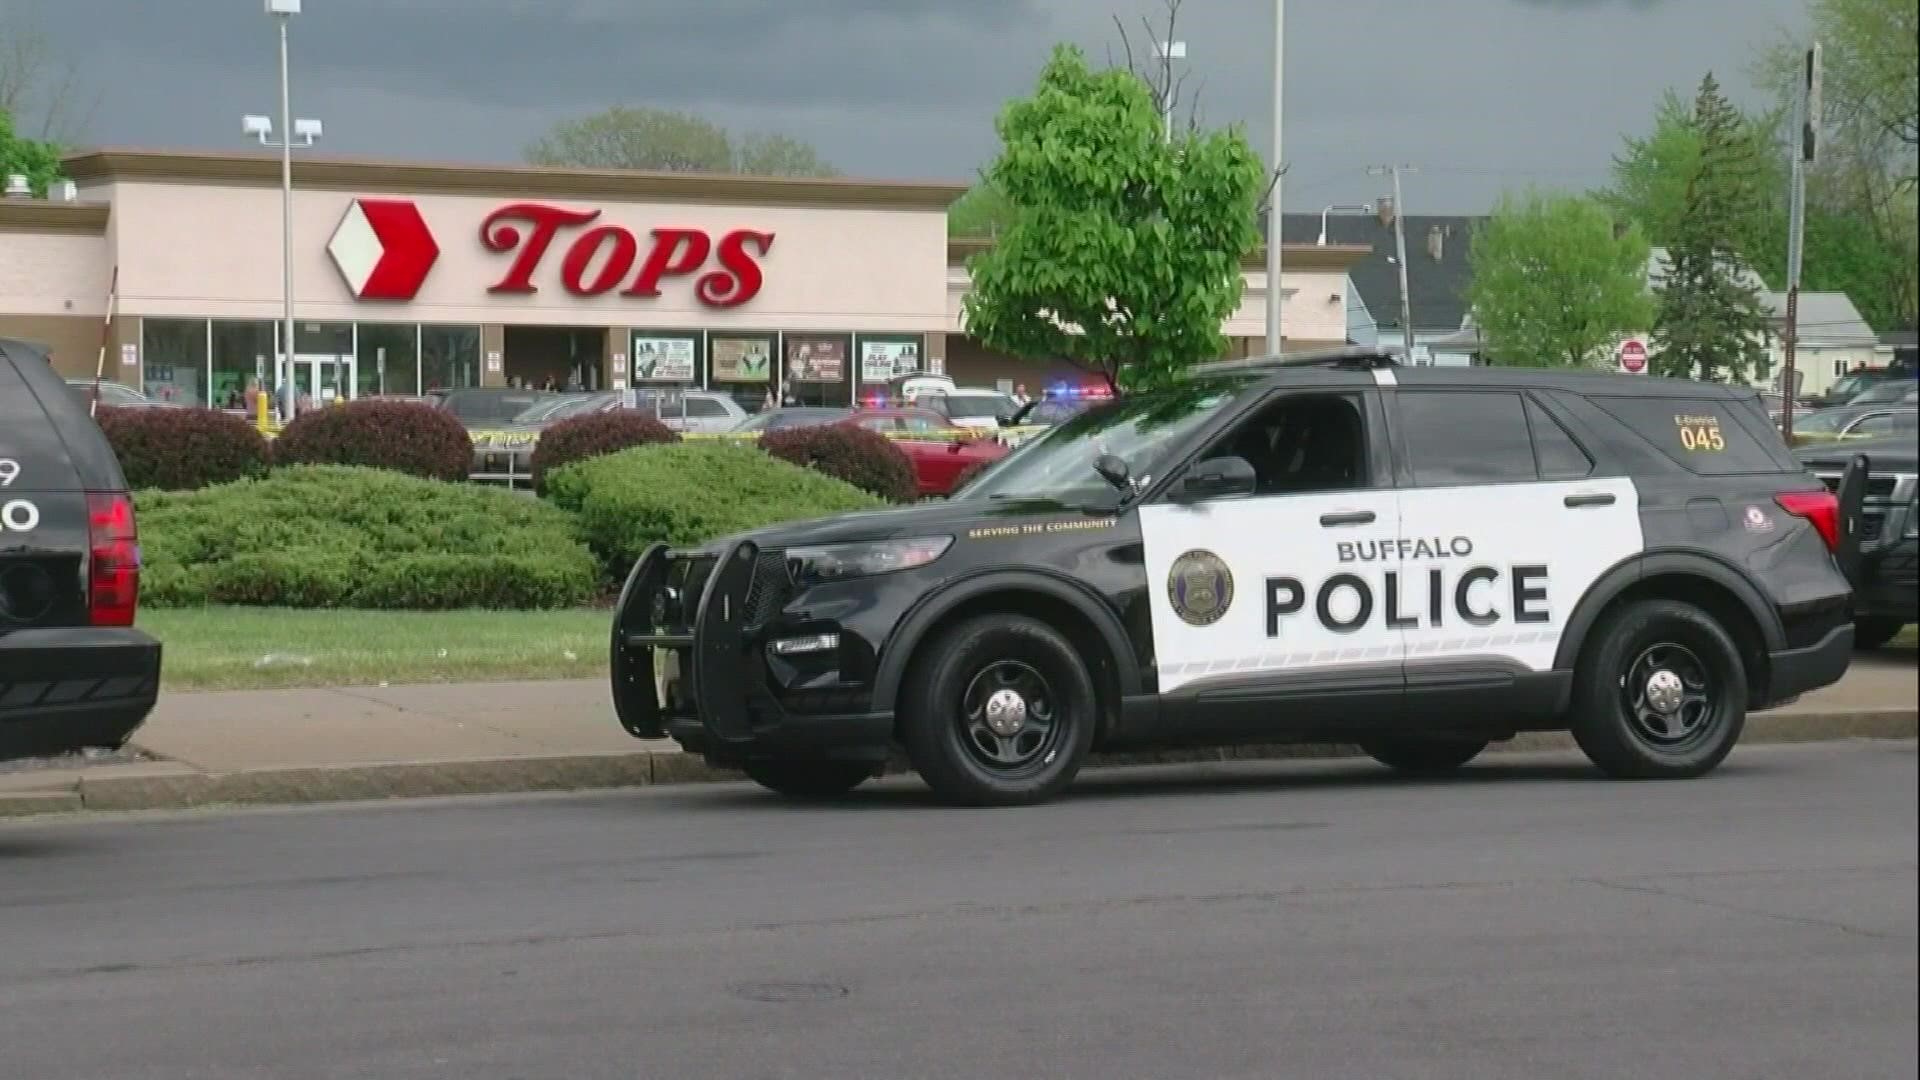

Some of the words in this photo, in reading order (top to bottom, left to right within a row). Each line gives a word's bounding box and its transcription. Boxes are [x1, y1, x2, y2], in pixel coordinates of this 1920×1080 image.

[480, 203, 776, 308] TOPS
[1680, 426, 1725, 450] 045
[968, 526, 1020, 538] SERVING
[1022, 523, 1043, 535] THE
[1046, 518, 1118, 533] COMMUNITY
[1336, 535, 1474, 563] BUFFALO
[1264, 564, 1551, 638] POLICE
